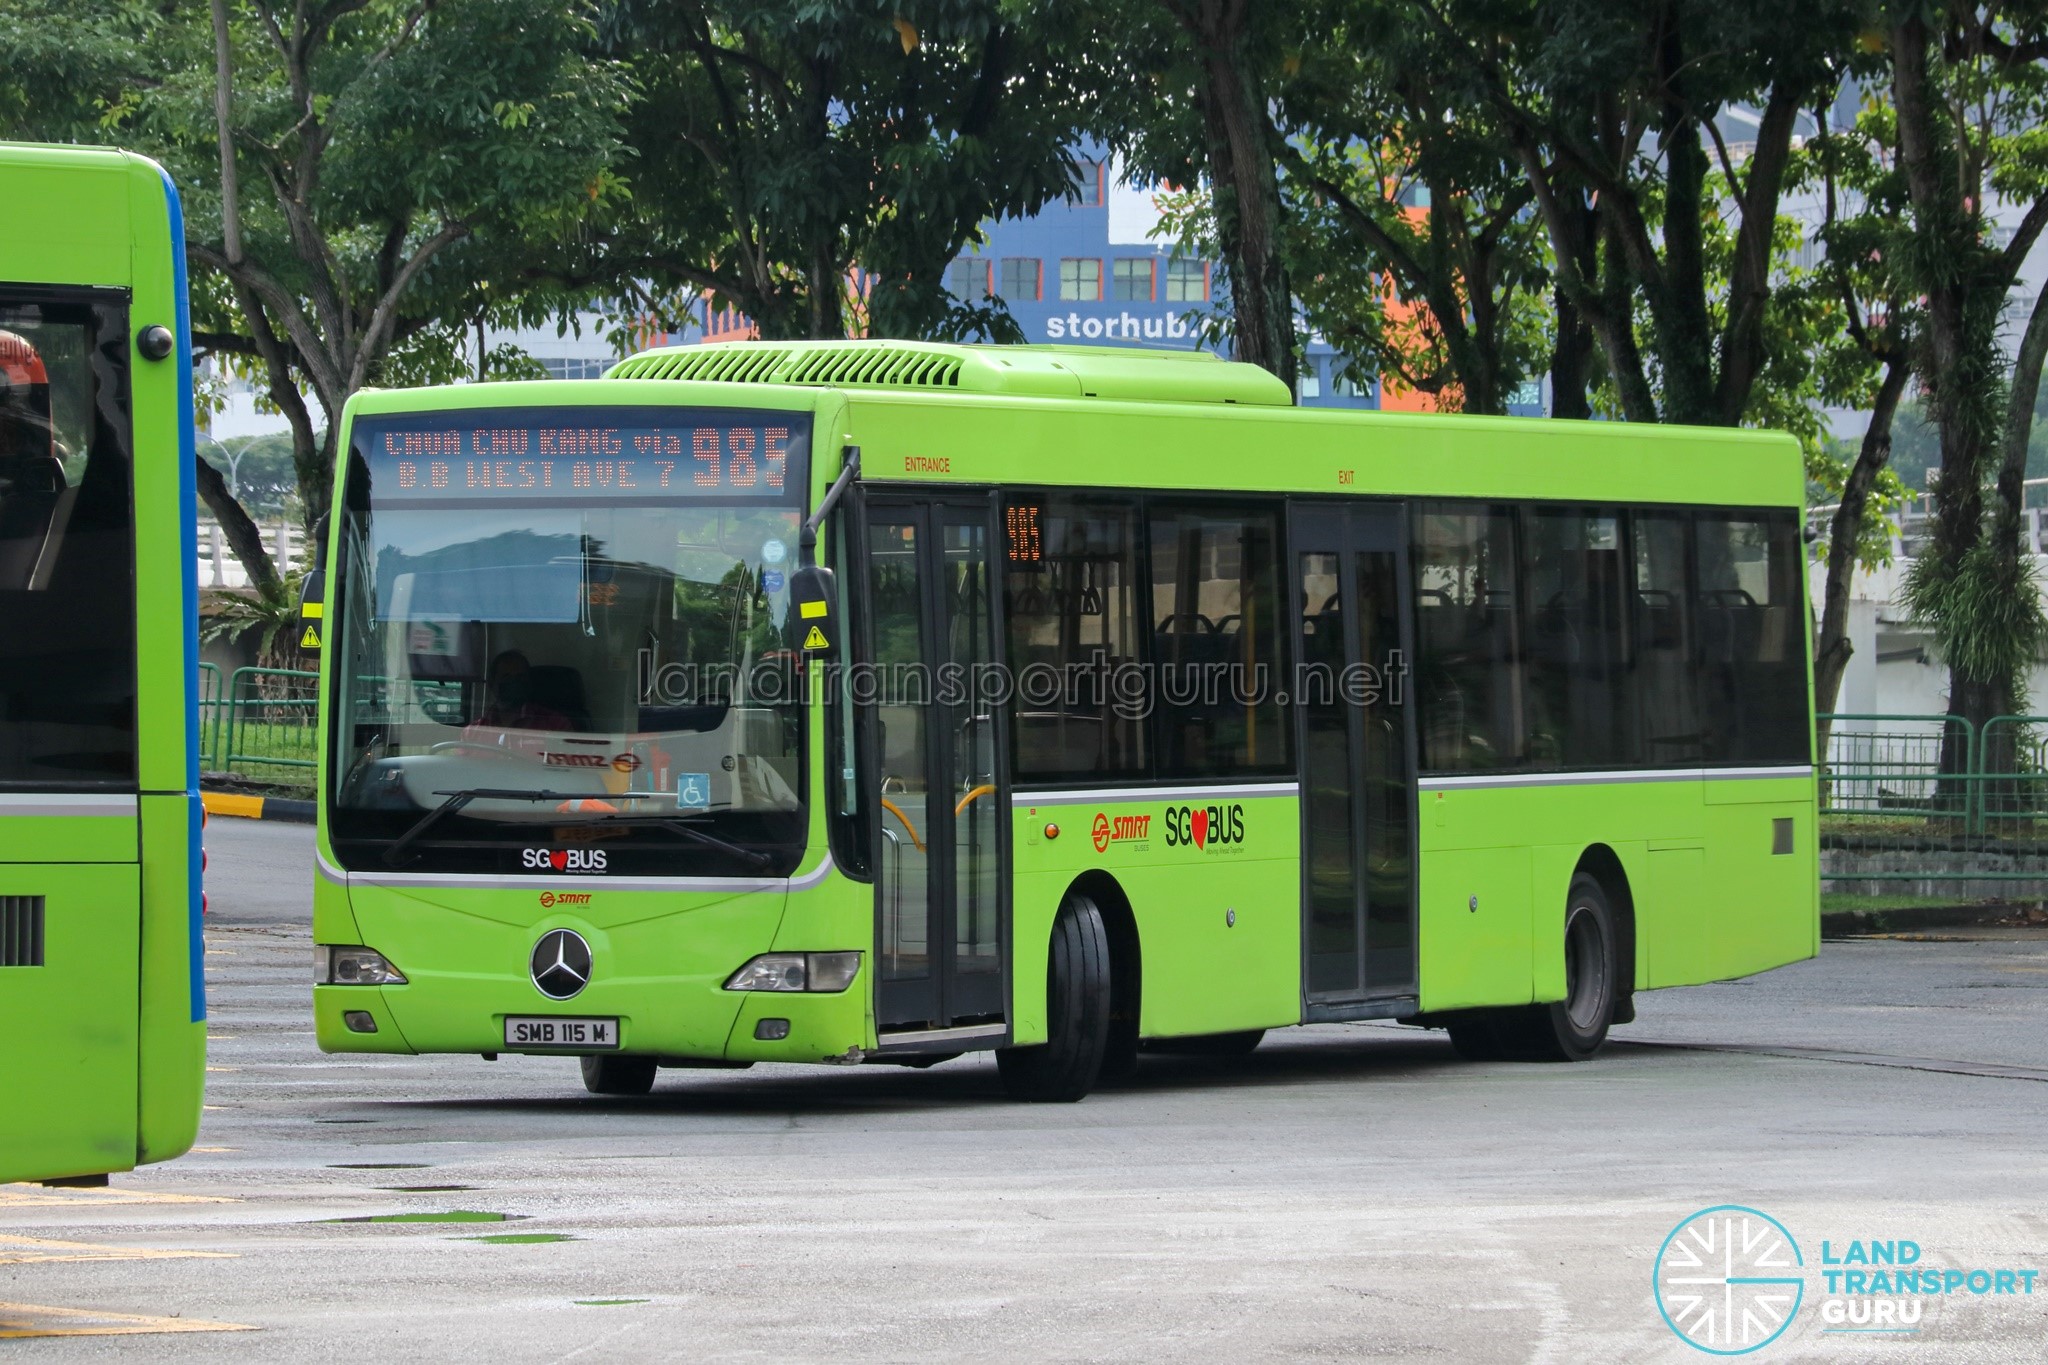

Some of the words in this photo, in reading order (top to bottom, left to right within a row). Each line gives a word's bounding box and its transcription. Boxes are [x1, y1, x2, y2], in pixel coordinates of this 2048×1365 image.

[385, 429, 461, 456] CHUA
[472, 429, 528, 455] CHU
[539, 429, 622, 455] KANG
[633, 428, 682, 455] via
[693, 427, 789, 487] 985
[904, 456, 951, 474] ENTRANCE
[399, 461, 449, 488] B.B
[466, 462, 553, 488] WEST
[573, 461, 636, 487] AVE
[655, 461, 675, 487] 7
[1338, 470, 1355, 486] EXIT
[1007, 506, 1040, 561] 985
[1111, 815, 1151, 840] SMRT
[1207, 804, 1245, 844] BUS
[566, 849, 607, 869] BUS
[557, 893, 592, 904] SMRT
[516, 1023, 554, 1042] SMB
[562, 1023, 585, 1042] 115
[593, 1023, 605, 1042] M
